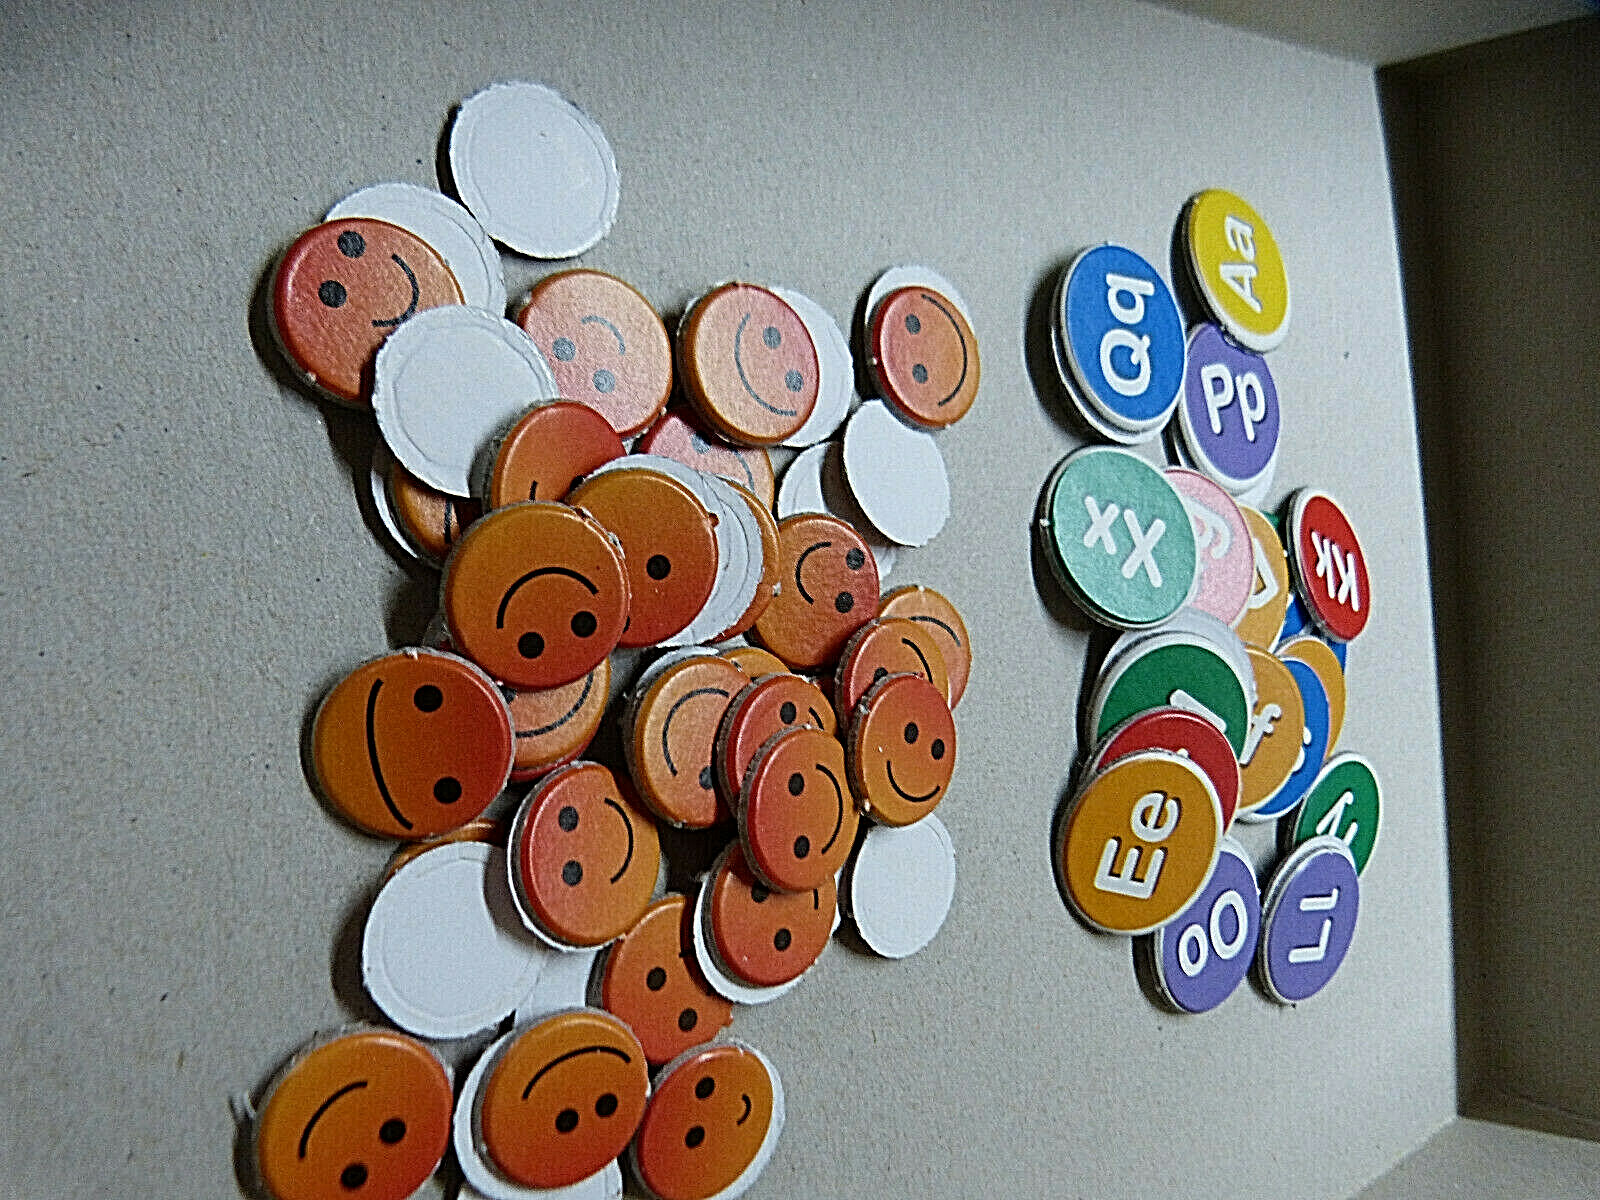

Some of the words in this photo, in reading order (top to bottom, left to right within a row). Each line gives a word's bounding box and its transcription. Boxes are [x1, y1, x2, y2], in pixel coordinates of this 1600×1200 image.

[1220, 215, 1262, 313] Aa
[1100, 272, 1155, 397] Qq
[1201, 363, 1266, 441] Pp
[1083, 496, 1166, 587] Xx
[1311, 531, 1359, 611] Kk
[1094, 792, 1179, 899] Ee
